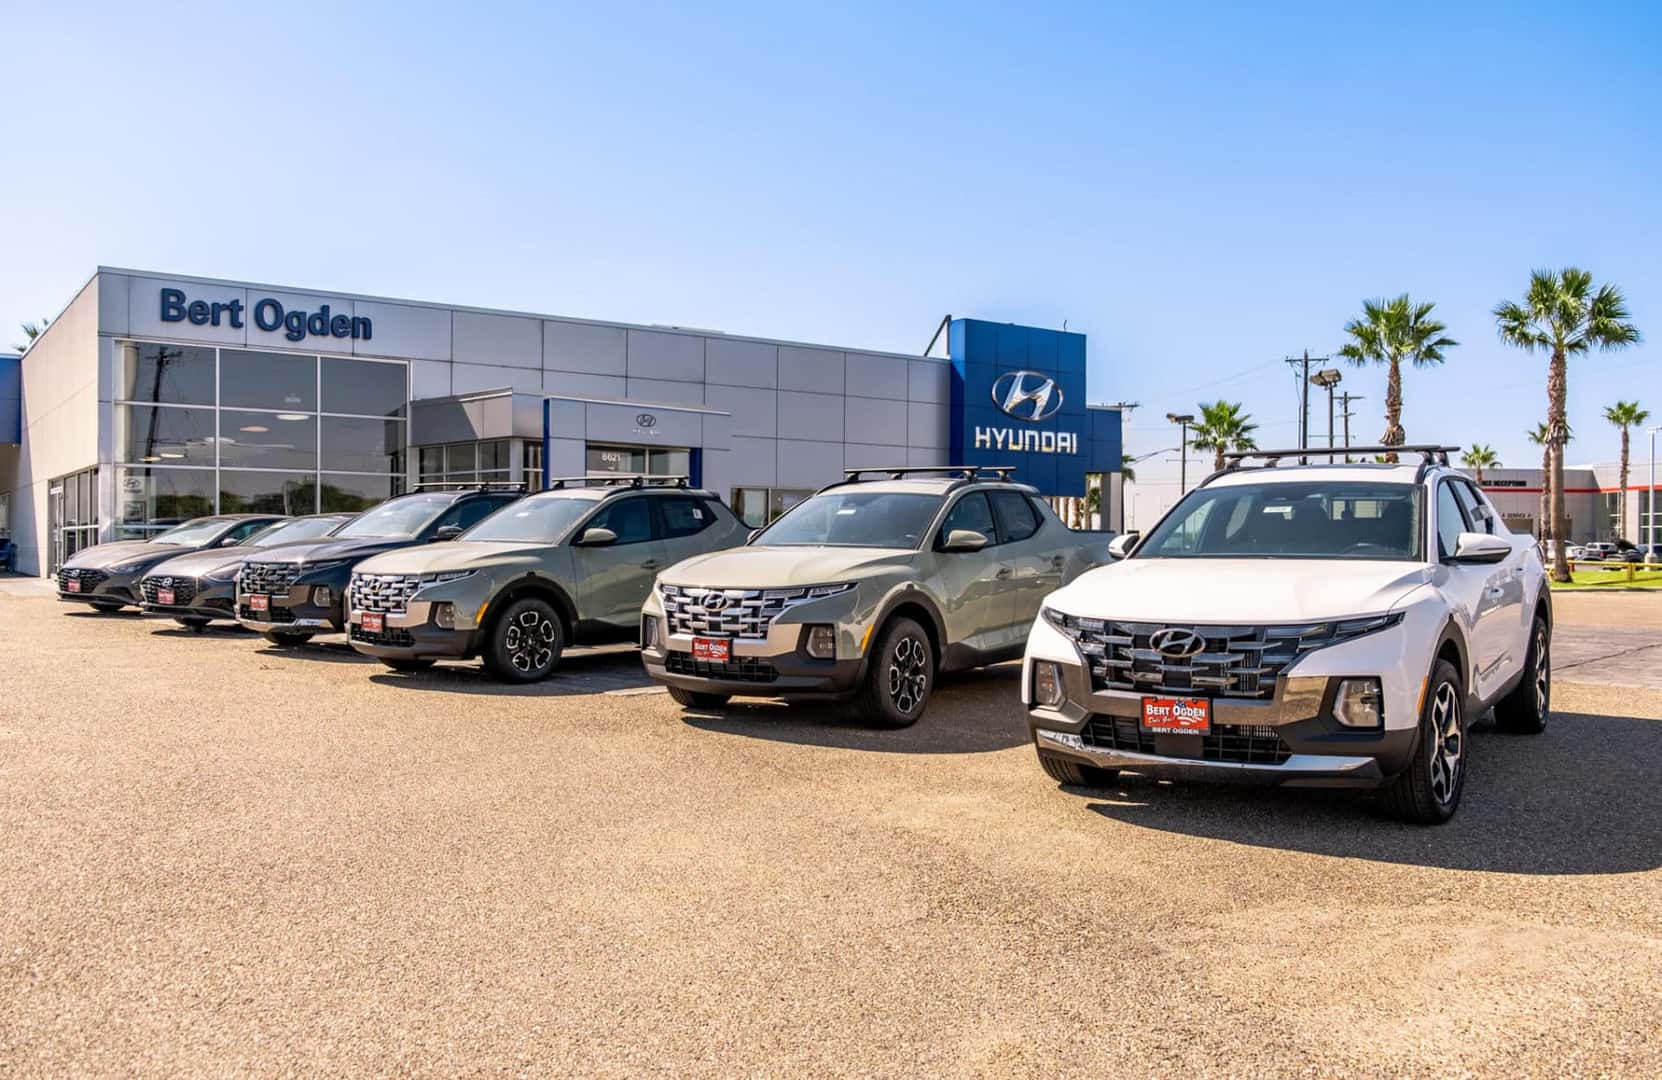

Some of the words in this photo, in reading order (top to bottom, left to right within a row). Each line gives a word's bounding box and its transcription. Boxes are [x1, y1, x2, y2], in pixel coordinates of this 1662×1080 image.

[160, 288, 244, 328] Bert
[255, 298, 373, 341] Ogden
[975, 426, 1077, 454] HYUNDAI
[1146, 704, 1170, 715] BERT
[1173, 705, 1205, 717] OGDEN
[1172, 727, 1199, 735] OGDEN
